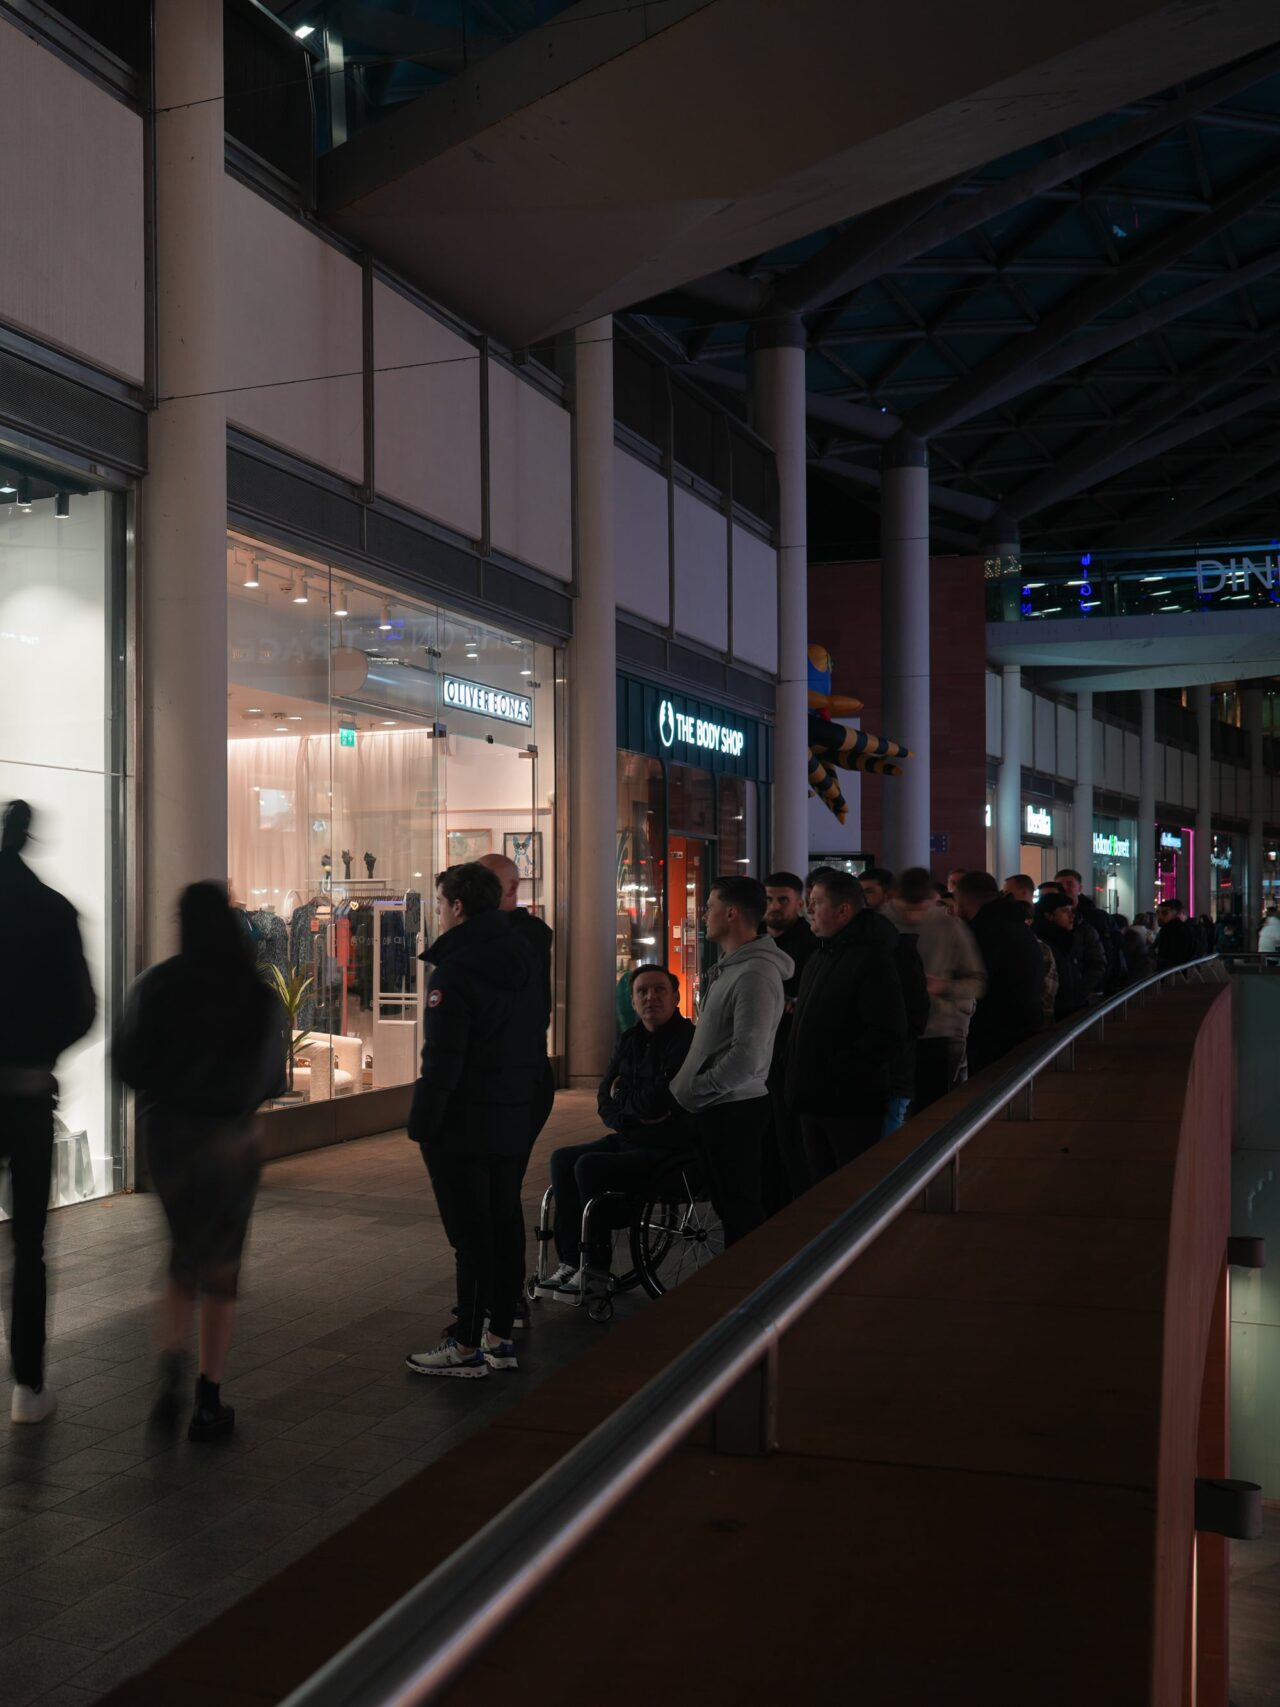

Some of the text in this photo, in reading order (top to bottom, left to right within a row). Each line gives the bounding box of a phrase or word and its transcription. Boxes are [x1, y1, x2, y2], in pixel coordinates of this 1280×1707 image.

[1196, 555, 1280, 594] DIN
[448, 681, 530, 720] OLIVER BONAS
[676, 713, 744, 756] THE BODY SHOP
